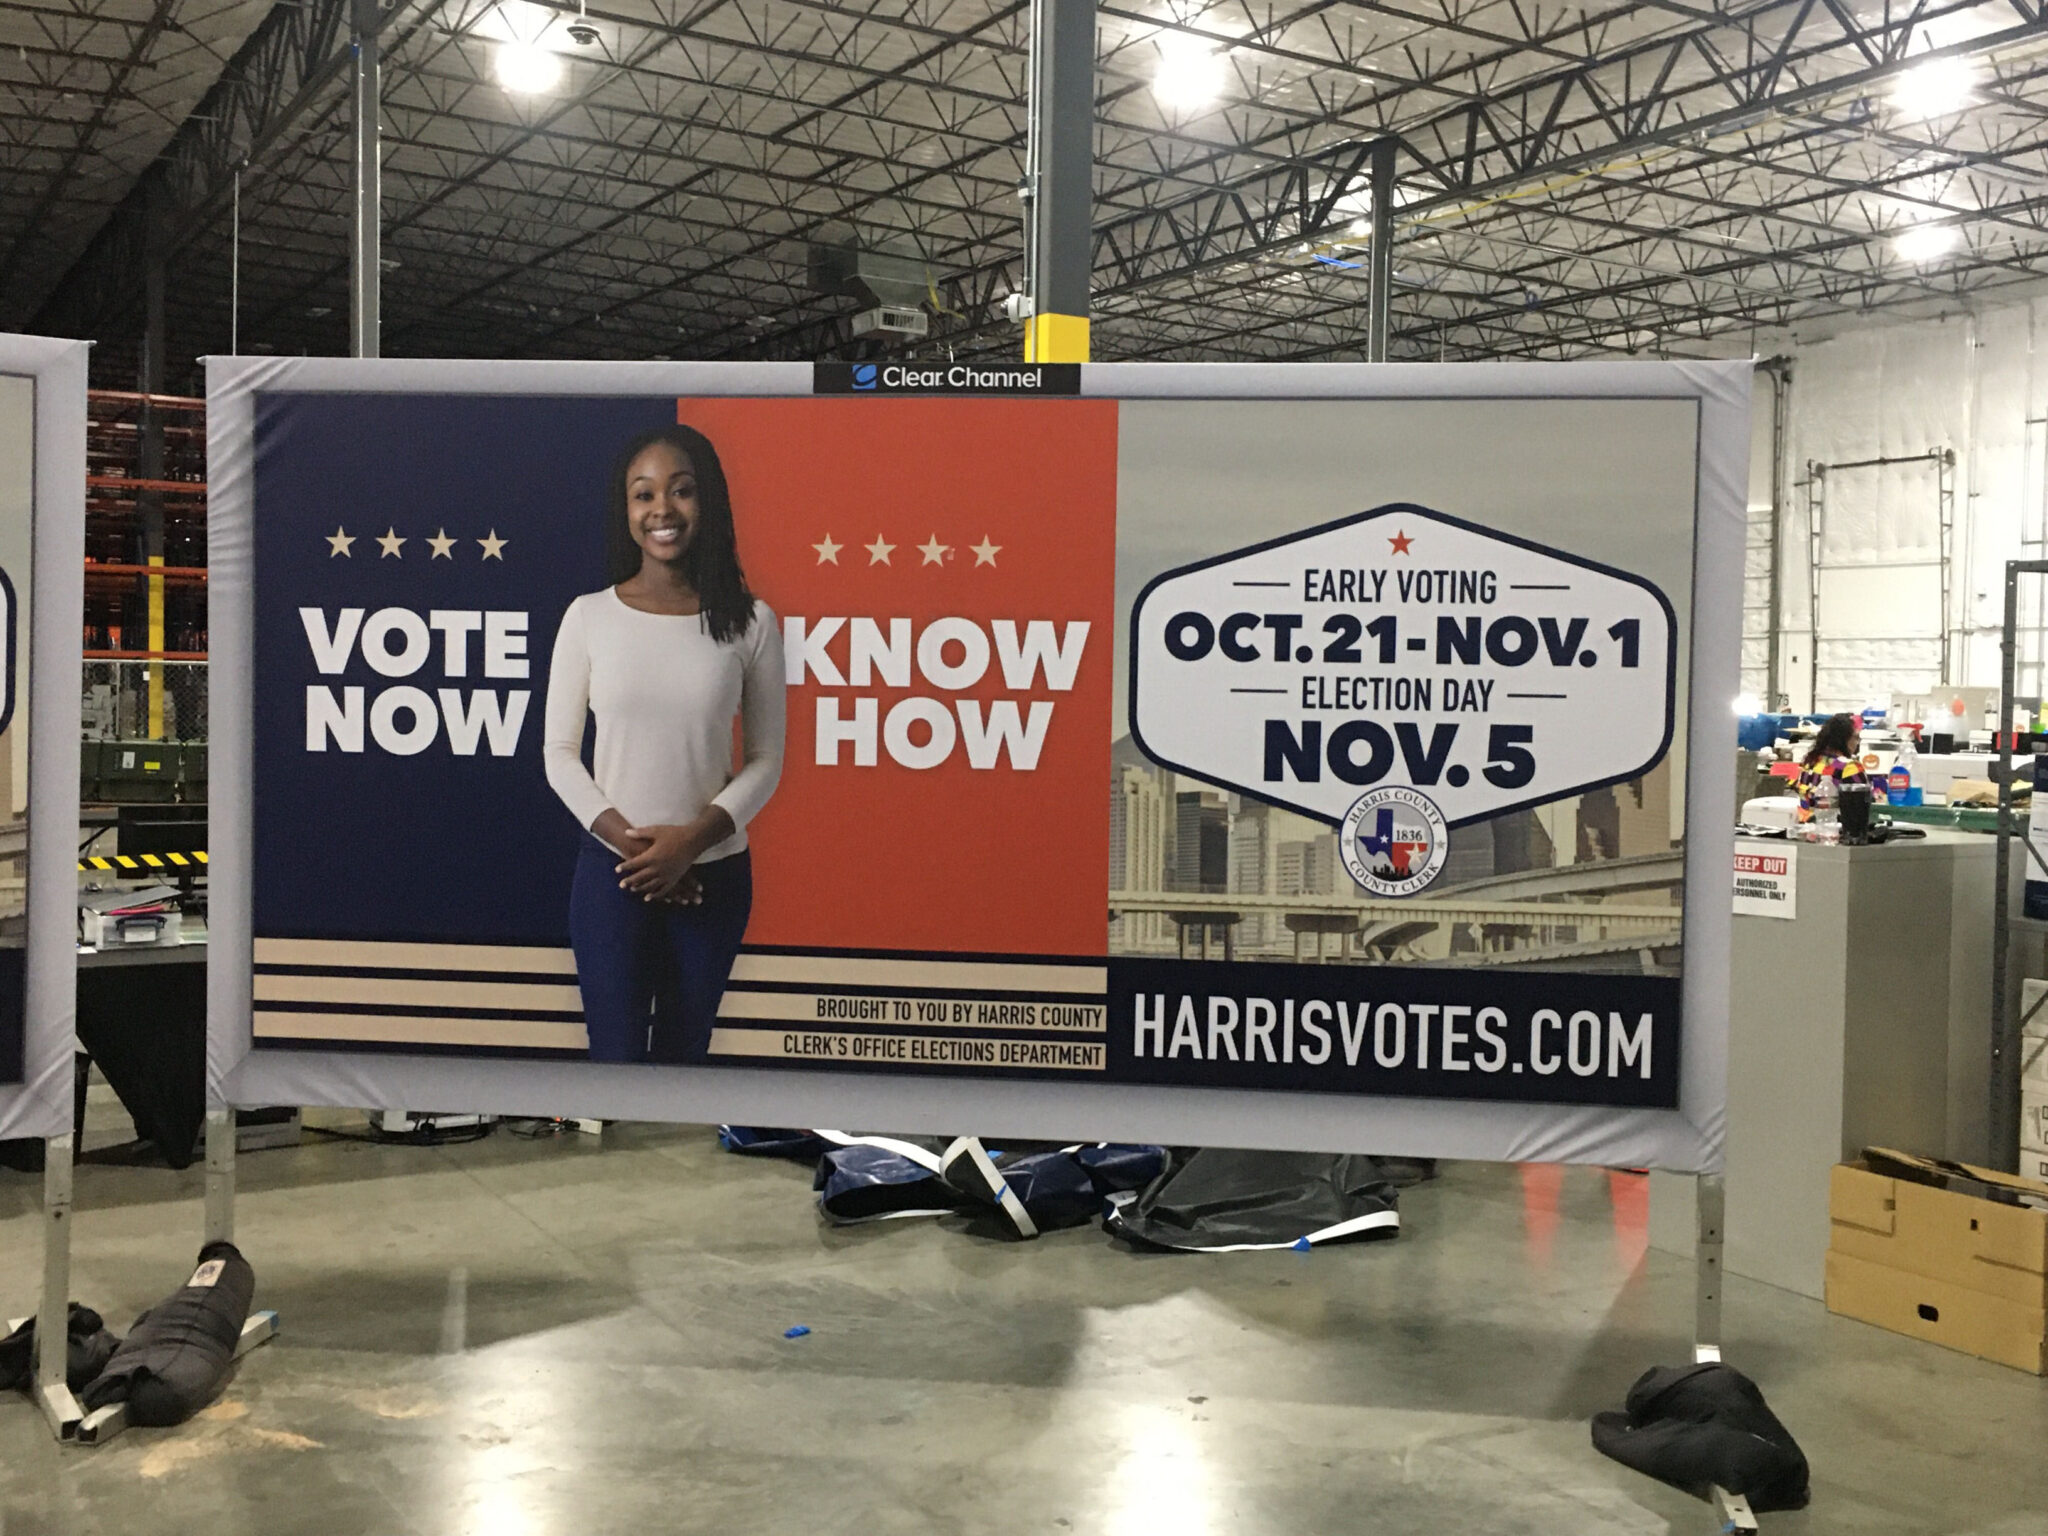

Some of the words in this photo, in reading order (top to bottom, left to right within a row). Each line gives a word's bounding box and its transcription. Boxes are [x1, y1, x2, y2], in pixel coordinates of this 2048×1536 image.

[883, 366, 943, 387] Clear
[948, 366, 1041, 388] Channel
[1304, 569, 1387, 603] EARLY
[1398, 570, 1497, 604] VOTING
[299, 606, 529, 679] VOTE
[784, 616, 1091, 691] KNOW
[1302, 676, 1432, 712] ELECTION
[1443, 679, 1495, 713] DAY
[306, 685, 531, 757] NOW
[815, 696, 1055, 771] HOW
[1349, 790, 1390, 824] HARRIS
[1394, 790, 1441, 826] COUNTY
[1396, 829, 1423, 842] 1836
[1349, 860, 1398, 894] COUNTY
[1401, 863, 1439, 892] CLERK
[1763, 858, 1786, 874] OUT
[1736, 878, 1778, 890] AUTHORIZED
[1769, 891, 1786, 901] ONLY
[817, 998, 889, 1020] BROUGHT
[893, 1001, 911, 1021] TO
[917, 1002, 947, 1022] YOU
[953, 1004, 972, 1023] BY
[978, 1004, 1035, 1026] HARRIS
[1041, 1007, 1102, 1028] COUNTY
[784, 1034, 848, 1056] CLERK'S
[853, 1037, 906, 1059] OFFICE
[911, 1040, 995, 1063] ELECTIONS
[1000, 1043, 1102, 1066] DEPARTMENT
[1134, 993, 1653, 1079] HARRISVOTES.COM
